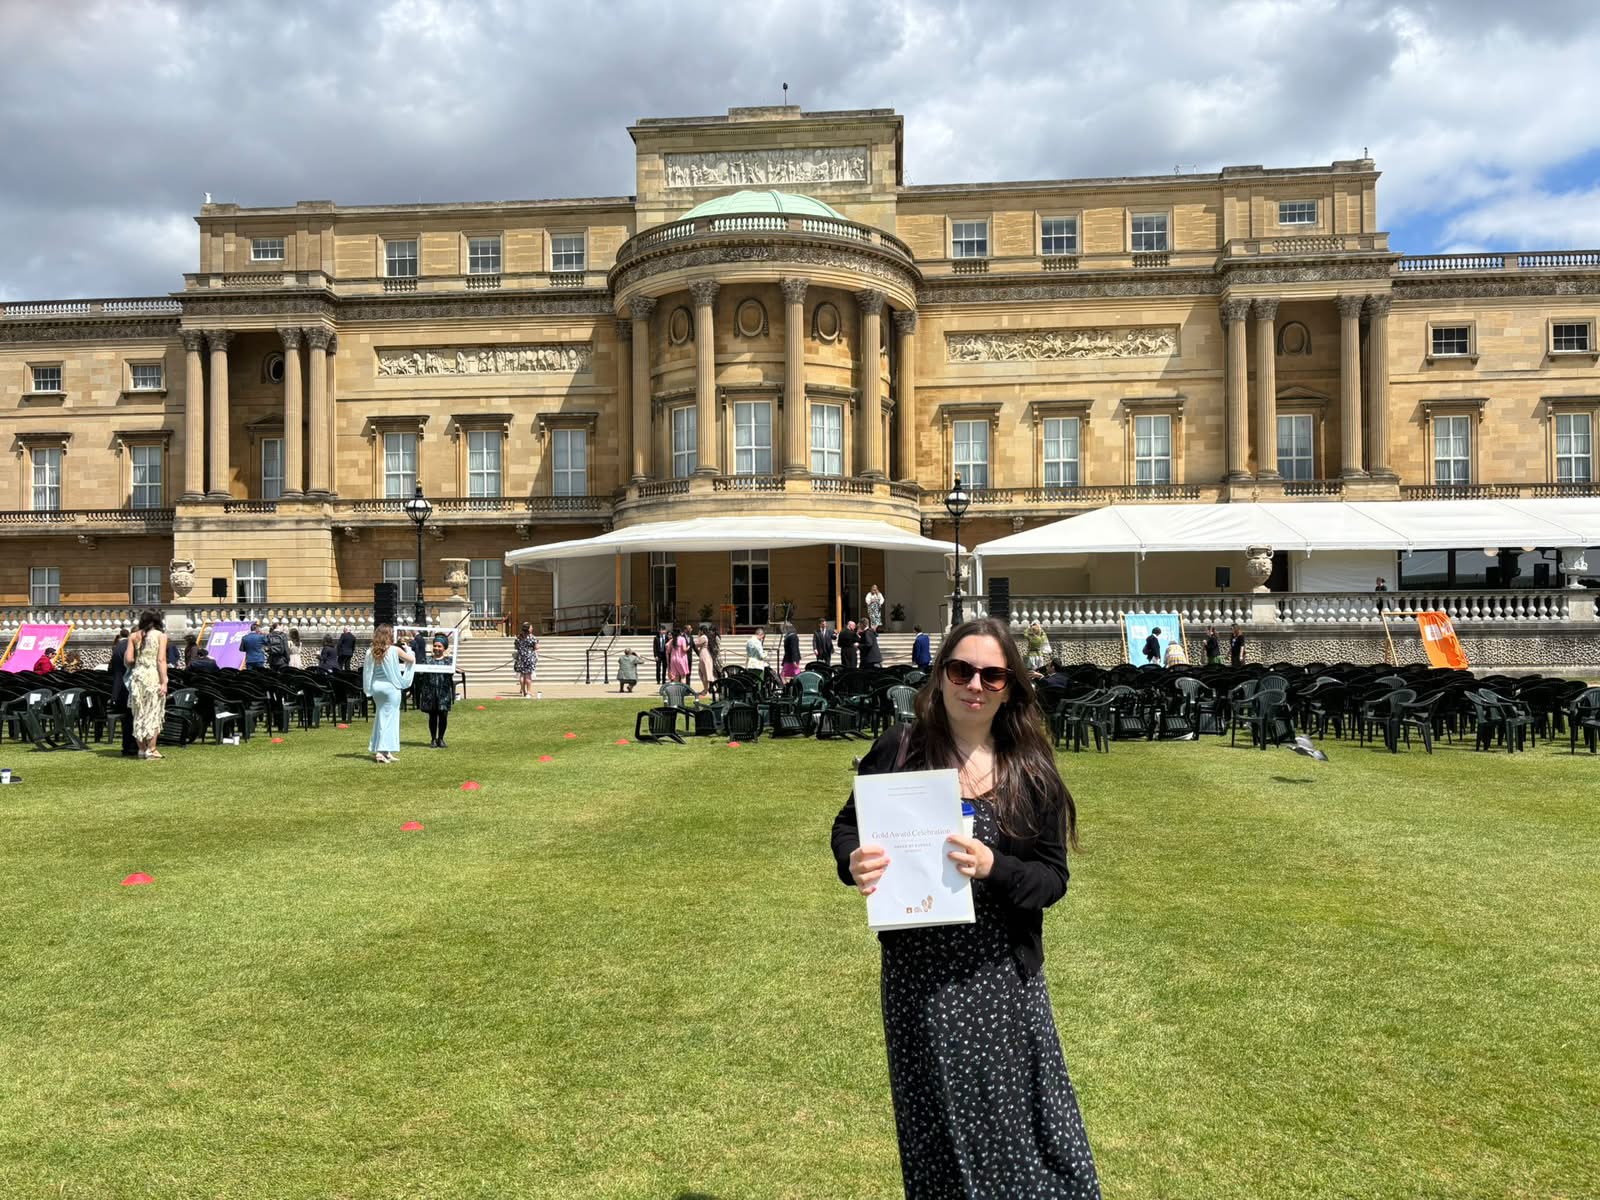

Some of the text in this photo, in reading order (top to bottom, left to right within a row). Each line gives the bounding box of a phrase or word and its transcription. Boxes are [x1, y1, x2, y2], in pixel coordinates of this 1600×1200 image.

[871, 827, 952, 840] Gold Award Celebration
